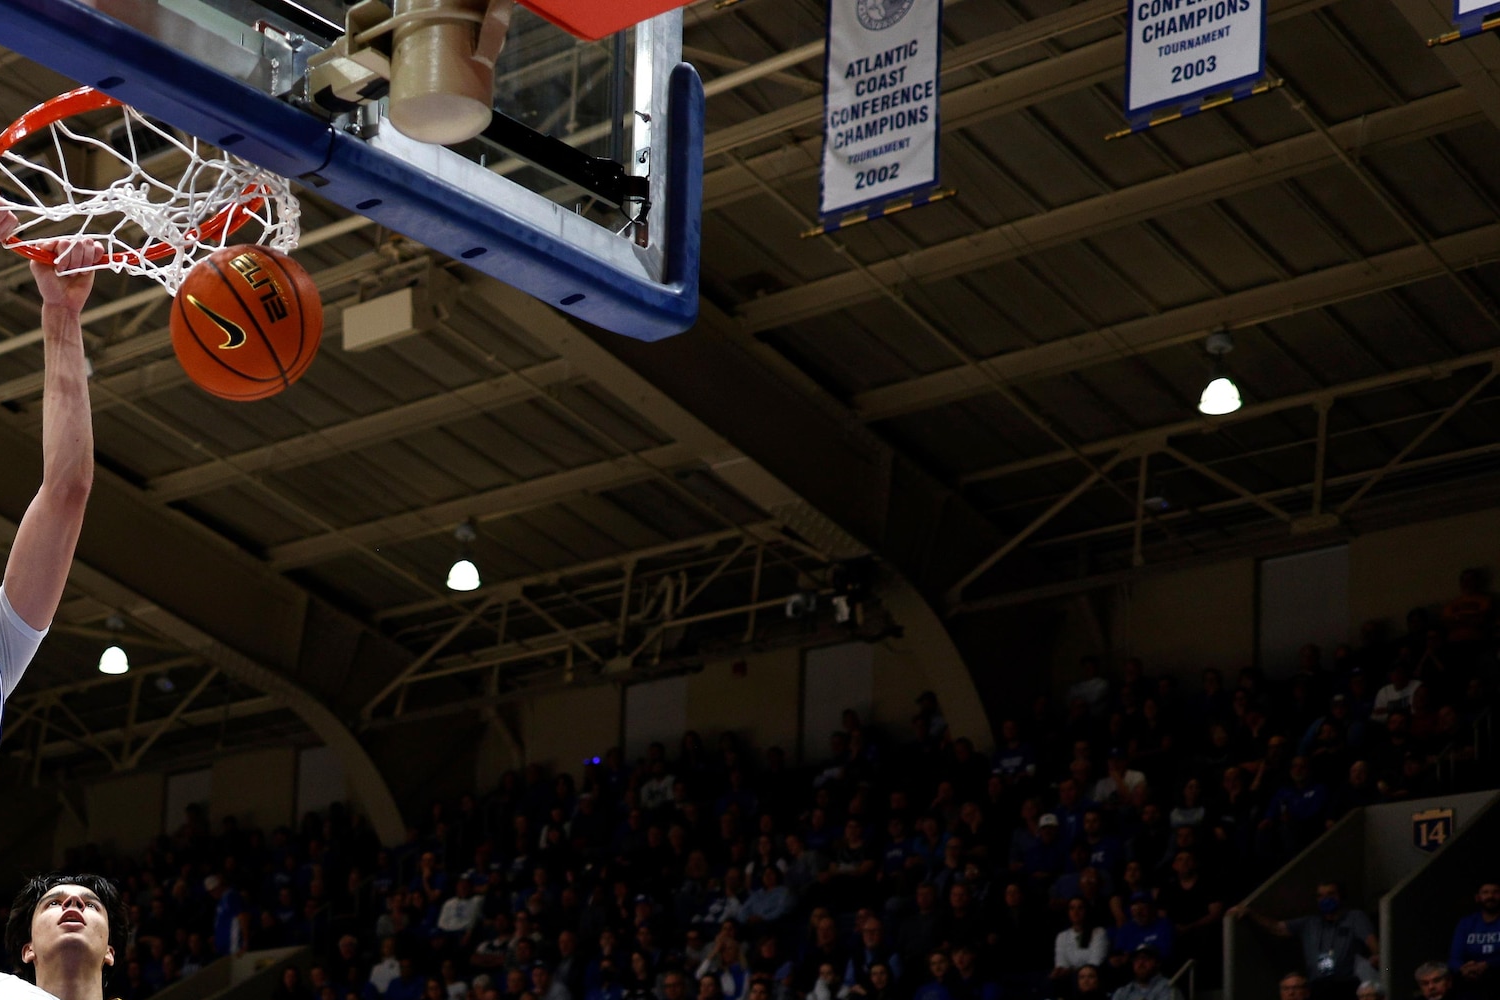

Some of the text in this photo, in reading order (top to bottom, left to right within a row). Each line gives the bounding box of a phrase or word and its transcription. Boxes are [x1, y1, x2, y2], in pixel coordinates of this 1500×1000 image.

[1142, 0, 1251, 44] CHAMPIONS
[1157, 25, 1231, 57] TOURNAMENT
[845, 39, 918, 79] ATLANTIC
[1171, 55, 1217, 84] 2003
[855, 66, 907, 97] COAST
[830, 80, 934, 129] CONFERENCE
[833, 106, 929, 150] CHAMPIONS
[847, 137, 911, 165] TOURNAMENT
[855, 163, 900, 190] 2002
[228, 252, 288, 324] ELITE
[1418, 821, 1447, 848] 14
